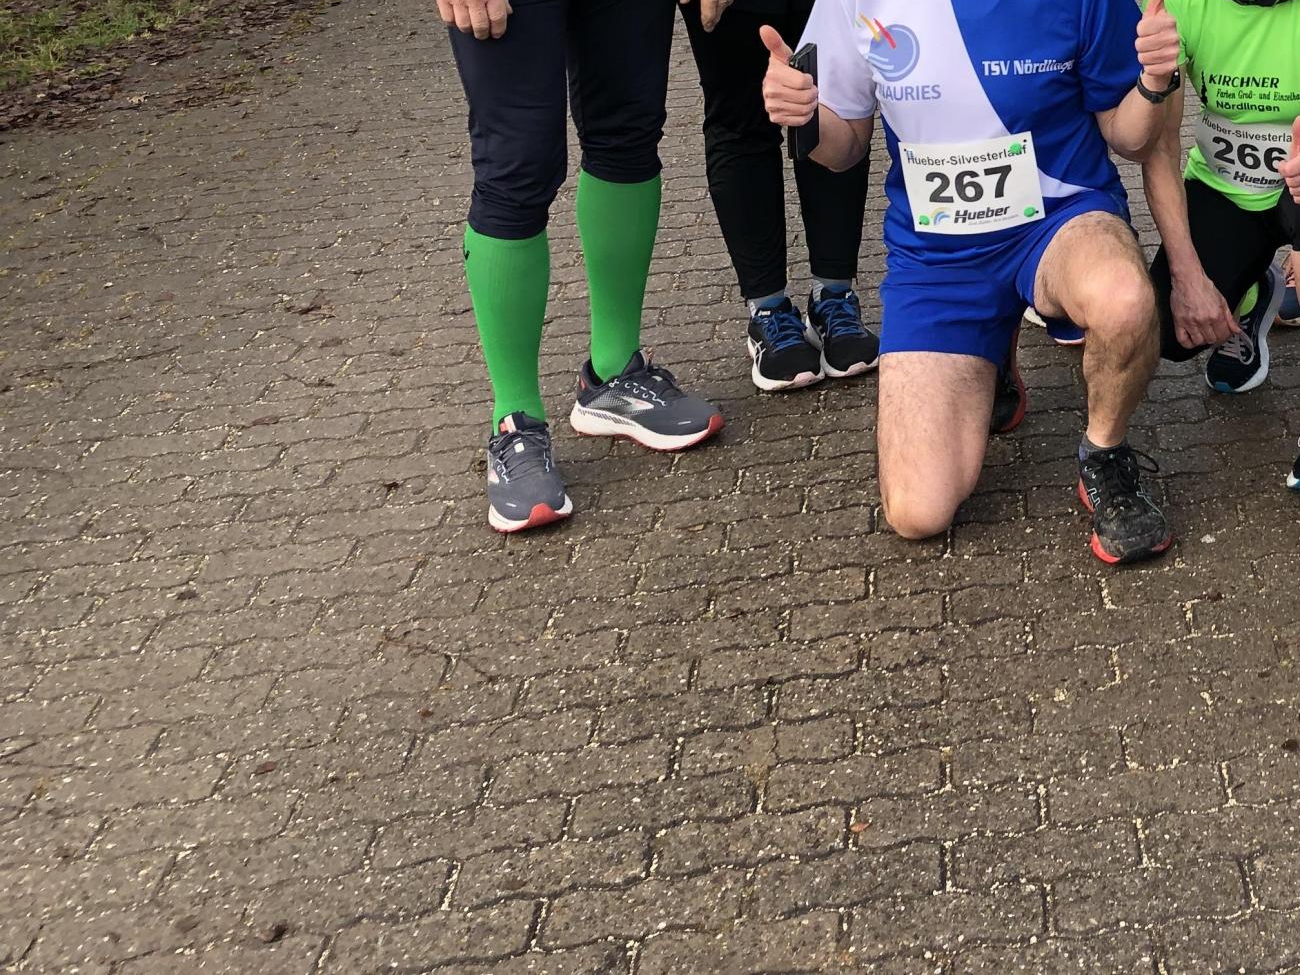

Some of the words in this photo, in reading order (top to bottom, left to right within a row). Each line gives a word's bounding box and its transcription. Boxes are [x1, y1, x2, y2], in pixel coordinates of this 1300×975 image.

[982, 60, 1010, 76] TSV
[1208, 74, 1280, 89] KIRCHNER
[1259, 91, 1271, 101] und
[1216, 101, 1281, 113] Nördlingen
[1201, 114, 1293, 143] Hueber-Silvesterla
[1212, 136, 1288, 174] 266
[925, 164, 1012, 203] 267
[1233, 171, 1283, 186] Hueber
[954, 205, 1010, 224] Hueber
